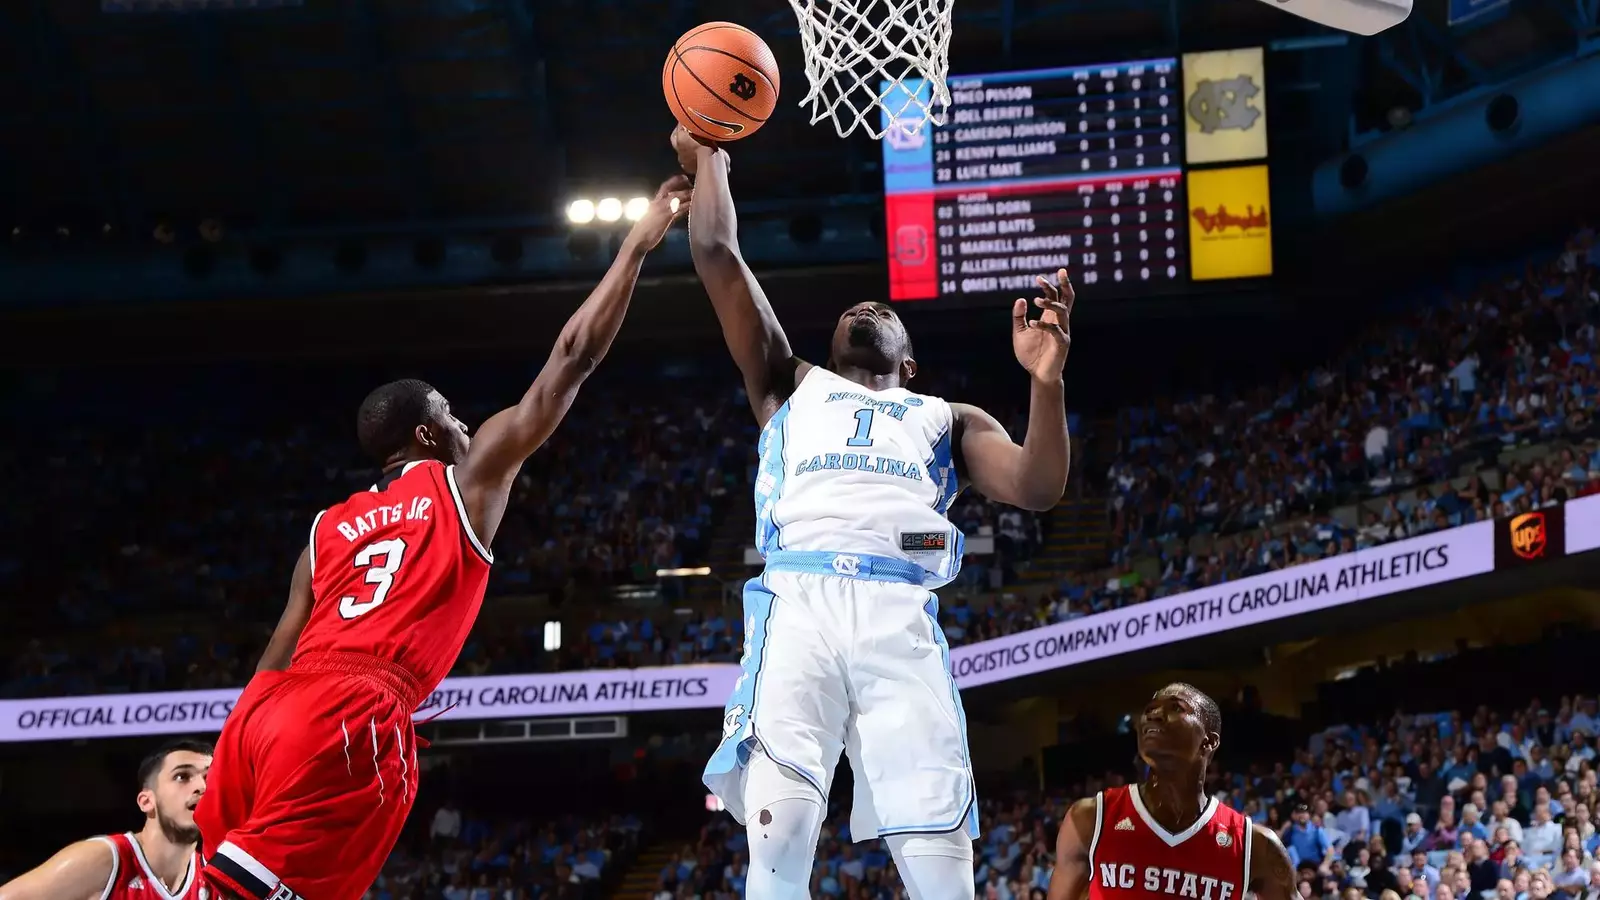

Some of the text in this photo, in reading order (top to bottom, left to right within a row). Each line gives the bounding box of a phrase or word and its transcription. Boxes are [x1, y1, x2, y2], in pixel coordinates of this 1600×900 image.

[954, 109, 981, 124] JOEL
[983, 106, 1024, 121] BERRY
[954, 126, 1012, 142] CAMERON
[1013, 121, 1066, 138] JOHNSON
[955, 145, 995, 161] KENNY
[996, 140, 1057, 158] WILLIAMS
[956, 165, 988, 180] LUKE
[989, 161, 1023, 176] MAYE
[958, 202, 995, 217] TORIN
[995, 200, 1031, 215] DORN
[959, 221, 997, 237] LAVAR
[997, 218, 1035, 234] BATTS
[960, 239, 1014, 254] MARKELL
[1016, 234, 1071, 251] JOHNSON
[960, 258, 1010, 273] ALLERIK
[1011, 253, 1069, 270] FREEMAN
[961, 277, 998, 293] OMER
[825, 391, 908, 422] NORTH
[846, 408, 874, 447] 1
[794, 452, 923, 481] CAROLINA
[337, 496, 433, 543] BATTS JR.
[338, 537, 409, 620] 3
[951, 544, 1449, 679] LOGISTICS COMPANY OF NORTH CAROLINA ATHLETICS
[18, 677, 708, 729] OFFICIAL LOGISTICS RTH CAROLINA ATHLETICS
[1100, 863, 1235, 900] NC STATE
